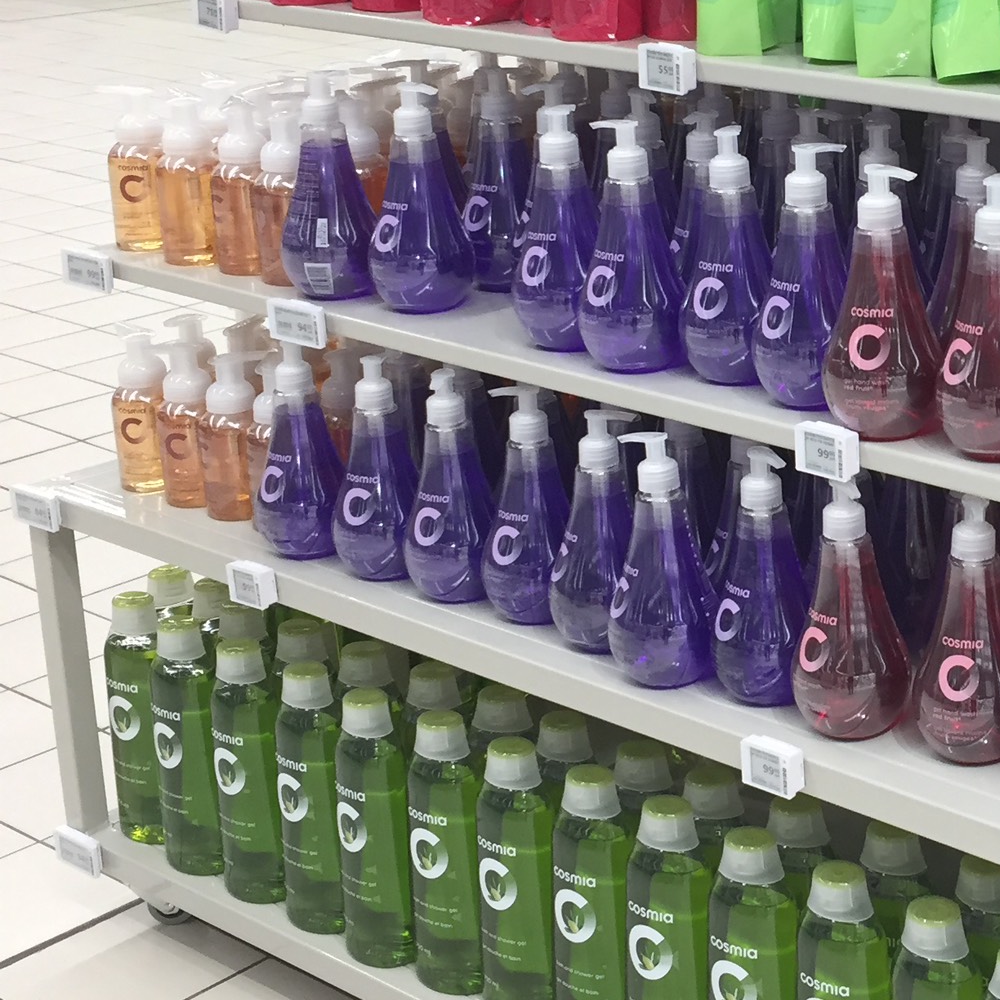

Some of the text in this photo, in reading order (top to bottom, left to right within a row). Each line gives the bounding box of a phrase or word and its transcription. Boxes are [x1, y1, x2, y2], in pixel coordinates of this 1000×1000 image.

[594, 248, 625, 263] cosmia
[698, 260, 734, 273] cosmia
[770, 277, 801, 293] cosmia
[850, 306, 894, 319] cosmia
[954, 319, 984, 336] cosmia
[347, 472, 380, 485] cosmia
[418, 491, 450, 504] cosmia
[497, 509, 529, 522] cosmia
[942, 635, 984, 650] cosmia
[106, 677, 138, 694] cosmia
[150, 702, 181, 721] cosmia
[211, 727, 244, 746] cosmia
[276, 752, 308, 773] cosmia
[335, 780, 367, 803] cosmia
[408, 805, 448, 827] cosmia
[477, 834, 517, 857] cosmia
[553, 865, 597, 888] cosmia
[628, 899, 674, 924] cosmia
[710, 935, 758, 960] cosmia
[800, 971, 850, 998] cosmia
